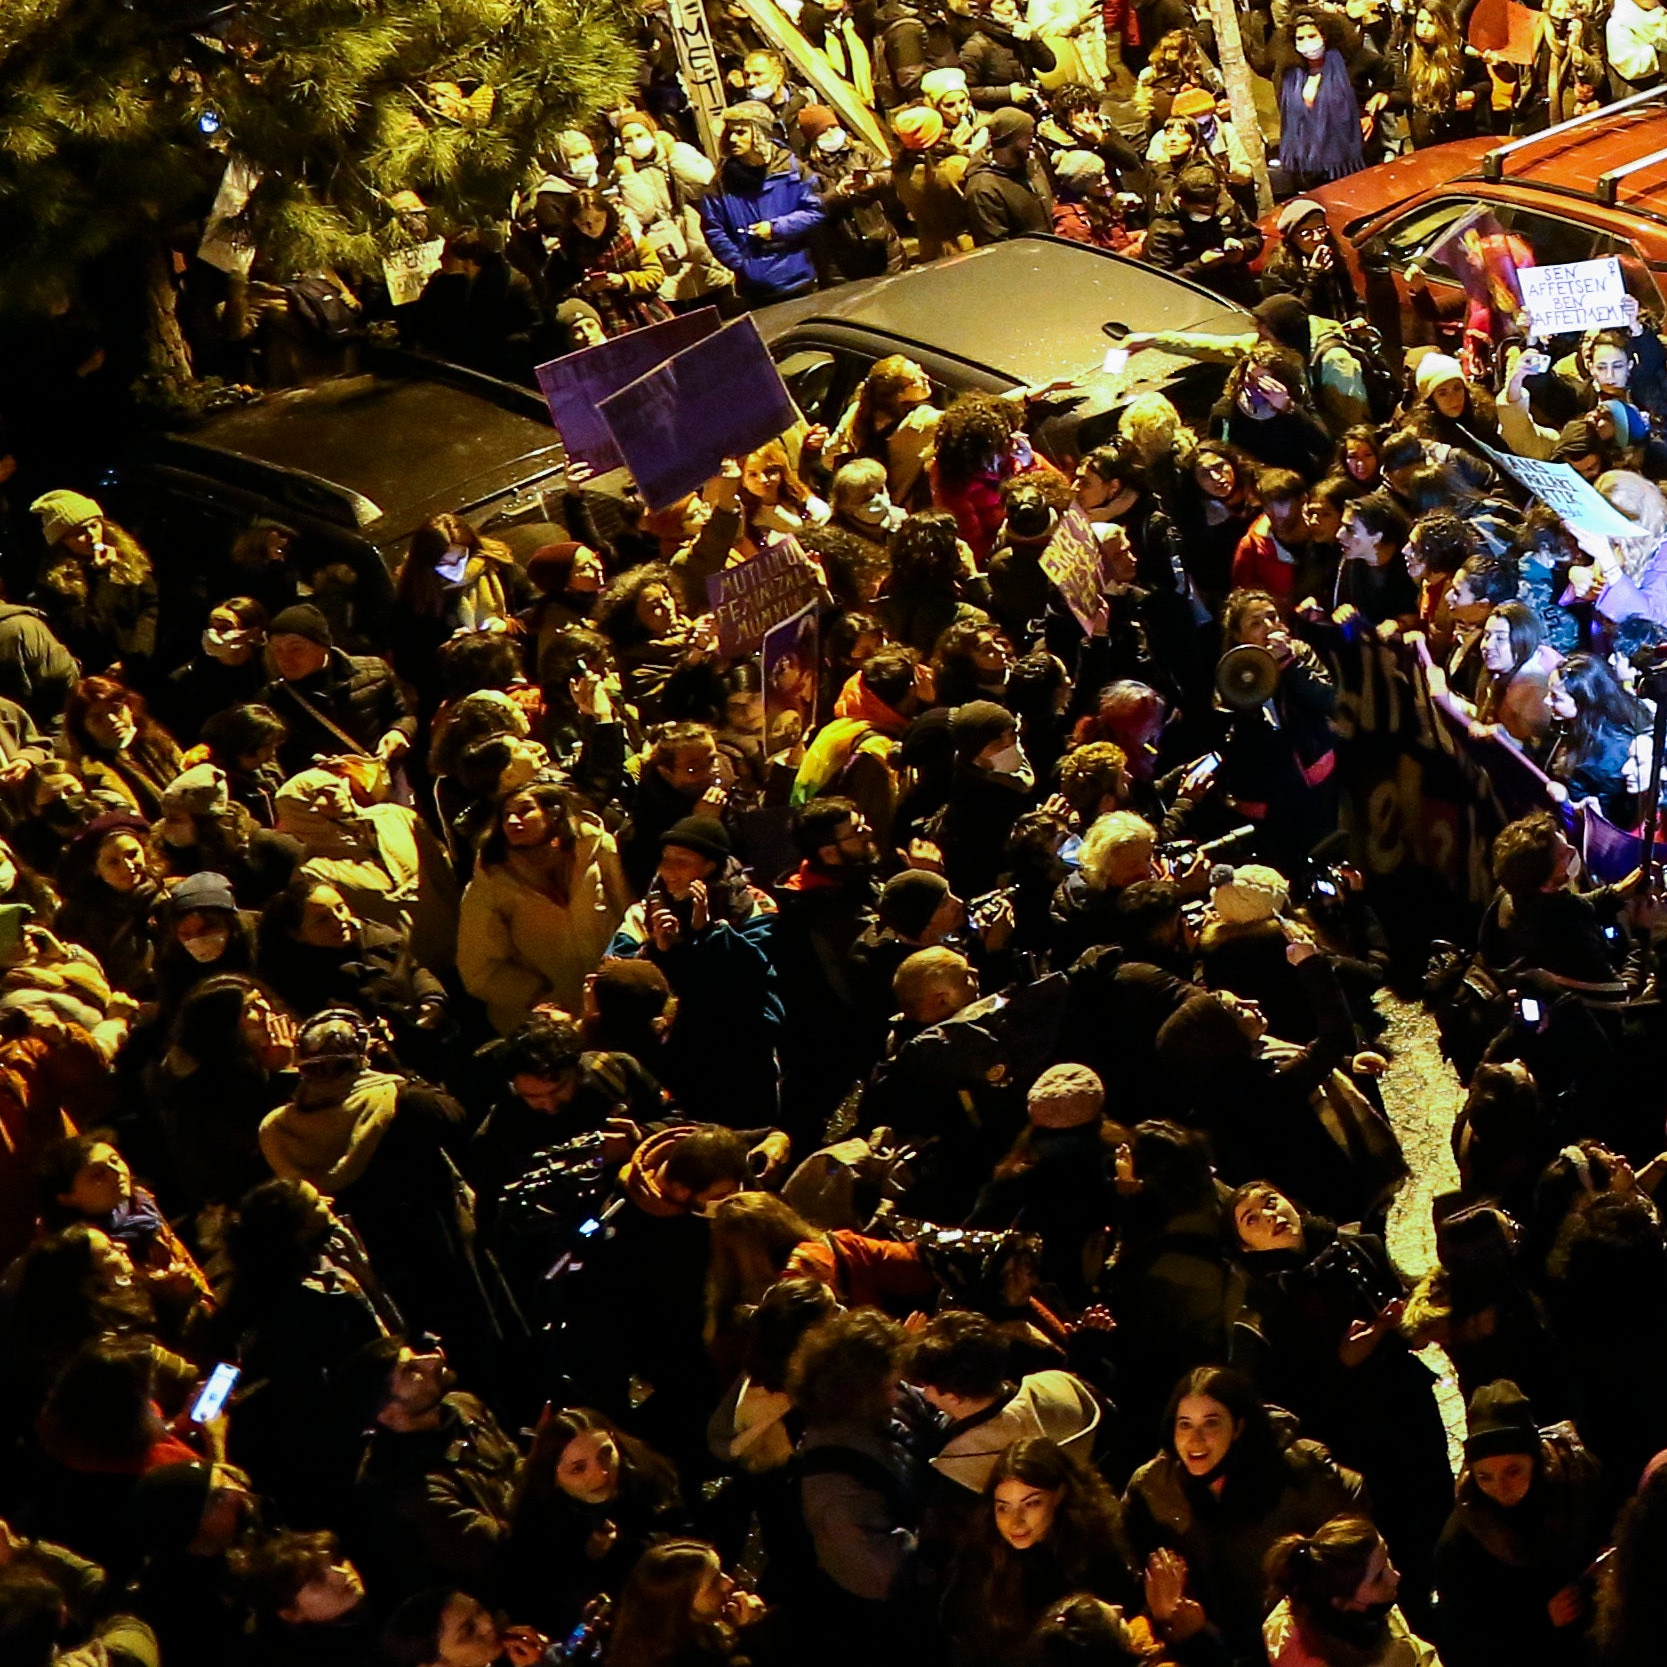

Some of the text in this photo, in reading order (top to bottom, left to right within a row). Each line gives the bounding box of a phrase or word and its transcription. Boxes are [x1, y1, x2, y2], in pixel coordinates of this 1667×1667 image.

[1544, 264, 1578, 281] SEN
[1529, 277, 1607, 297] AFFETSEN
[1553, 295, 1586, 310] BEN
